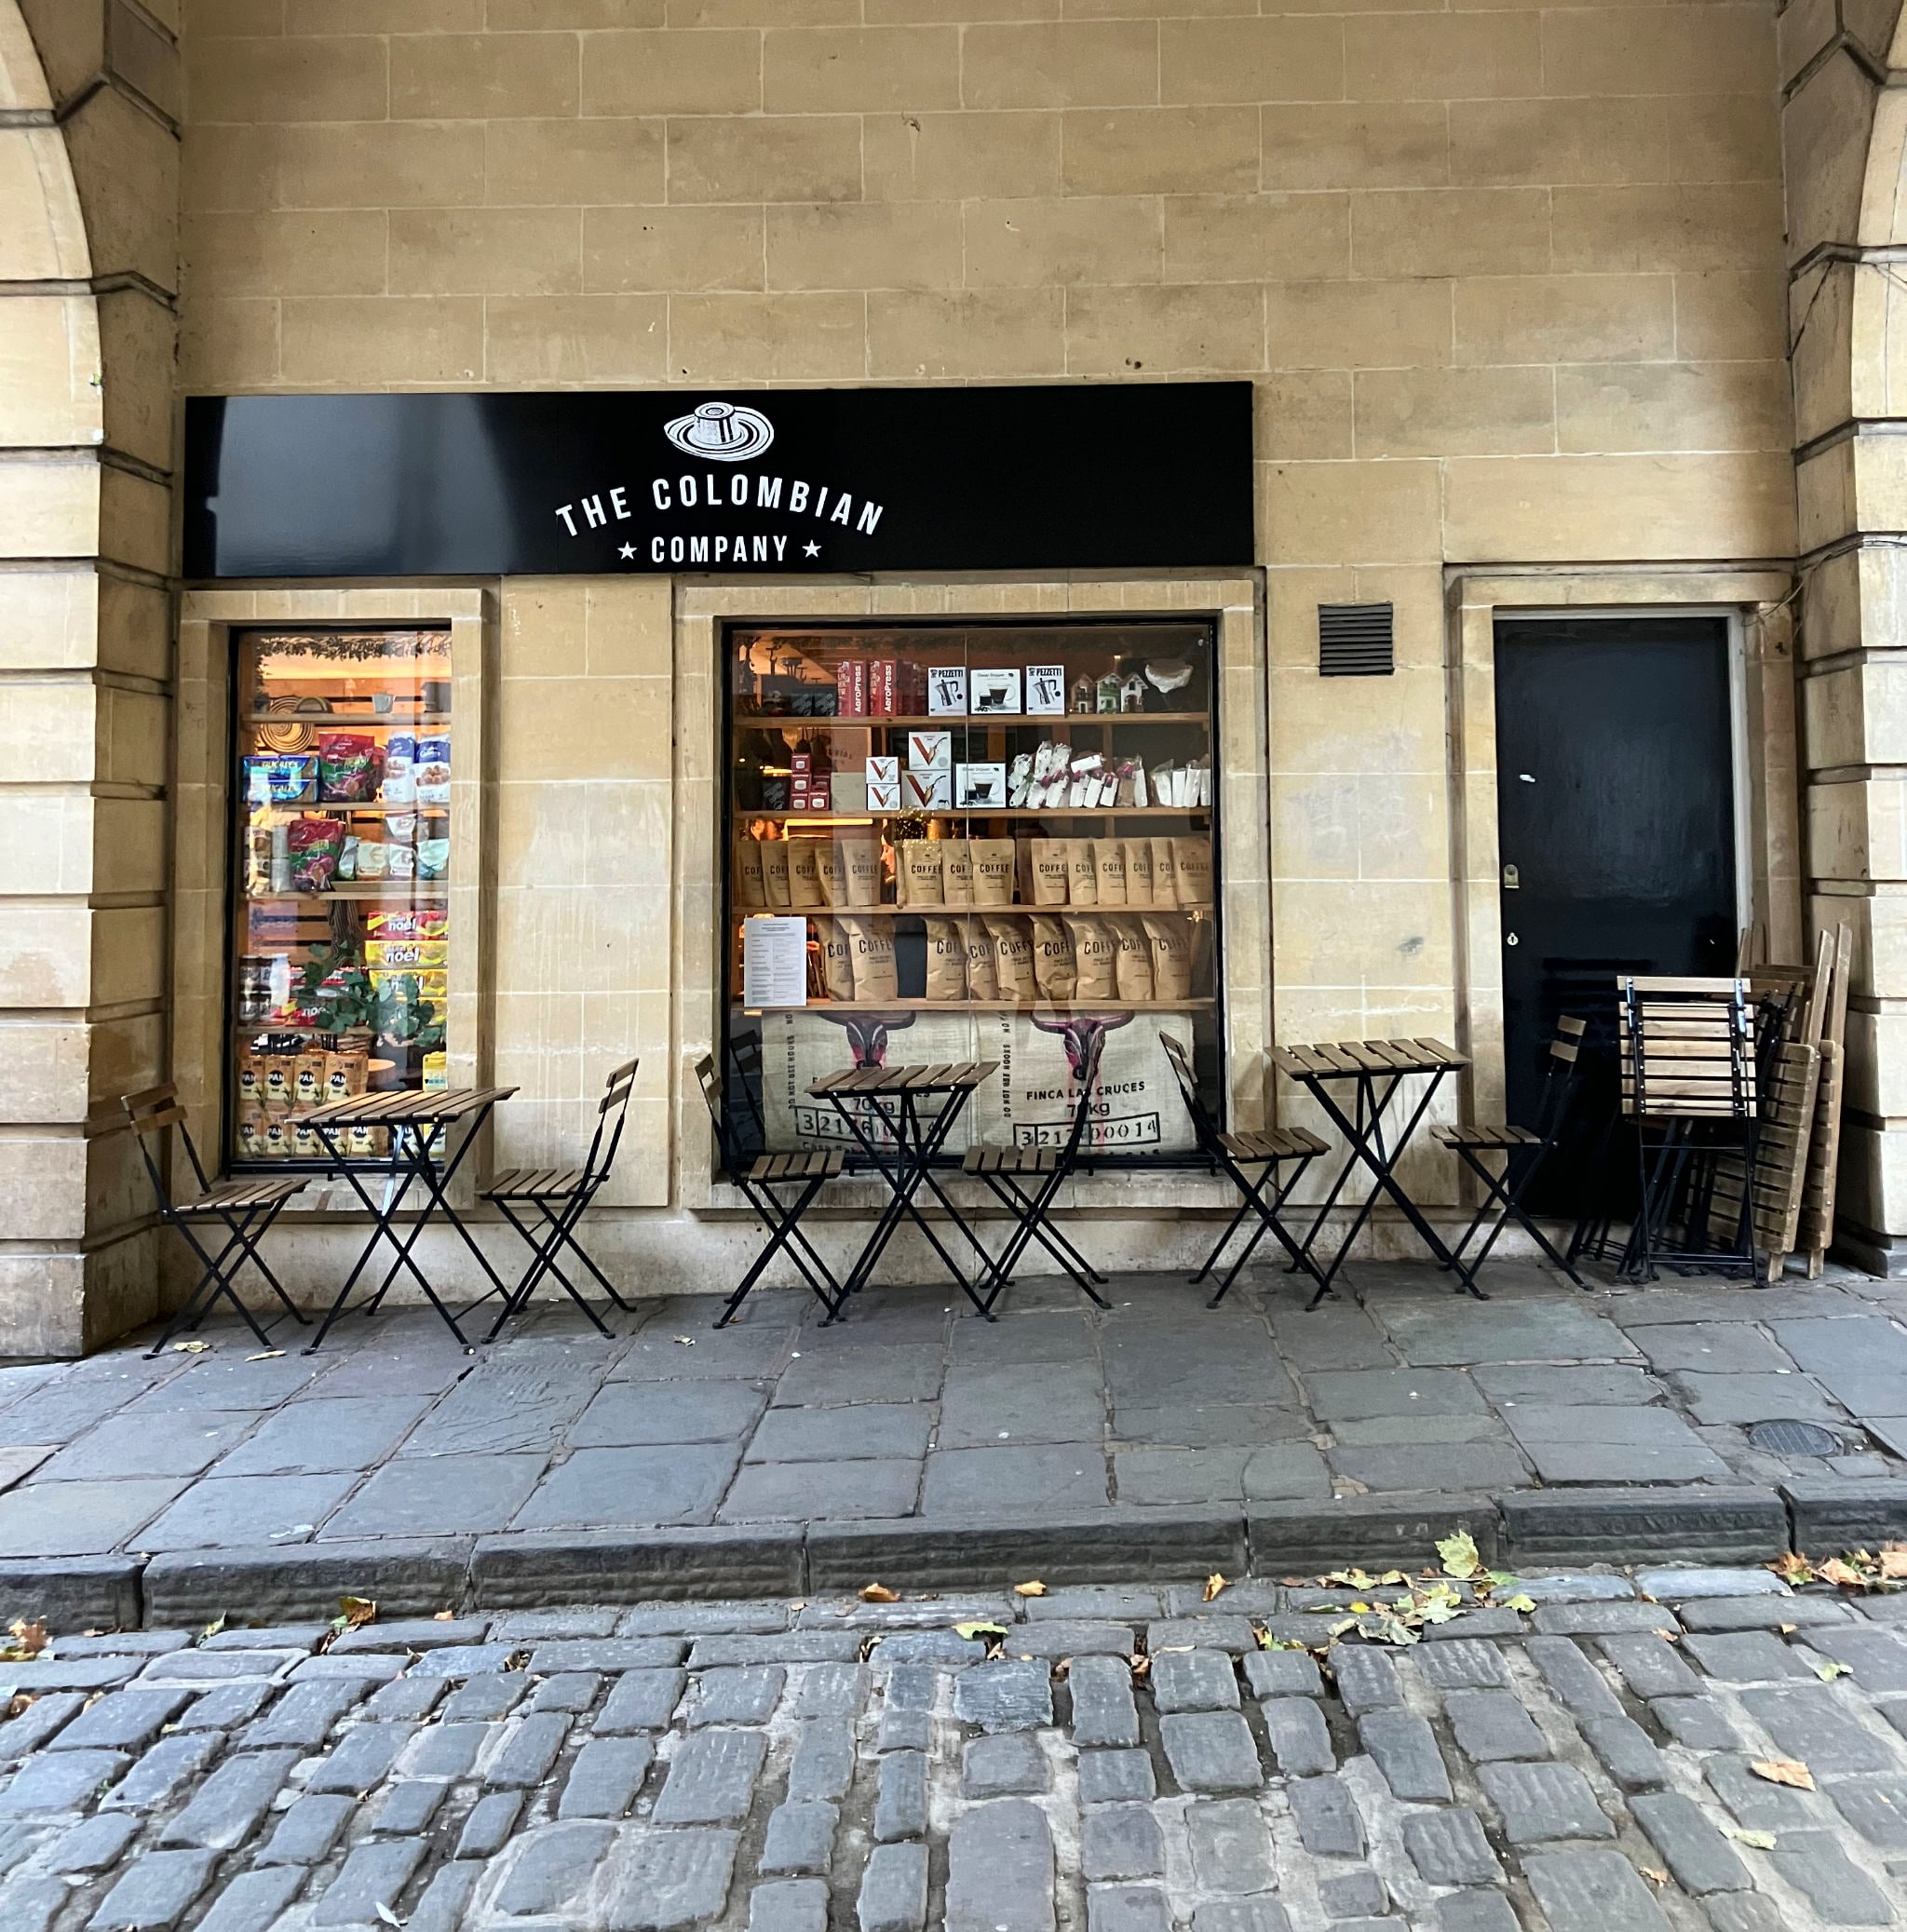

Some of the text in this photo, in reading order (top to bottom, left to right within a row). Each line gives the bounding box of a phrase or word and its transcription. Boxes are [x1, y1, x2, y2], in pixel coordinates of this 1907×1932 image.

[555, 473, 884, 537] THE COLOMBIAN
[651, 535, 788, 562] COMPANY
[938, 669, 964, 678] PEZZETTI
[1036, 668, 1062, 677] PEZZETTI
[884, 664, 892, 712] AeroPress
[852, 864, 878, 875] COFFEE
[980, 863, 1009, 873] COFFEE
[1039, 863, 1066, 873] COFFE
[388, 917, 416, 931] noel
[385, 947, 420, 963] noel
[1003, 1044, 1011, 1070] HOOKS
[268, 1073, 284, 1081] PAN
[299, 1074, 315, 1082] PAN
[330, 1074, 346, 1083] PAN
[1026, 1081, 1145, 1101] FINCA LA CRUCES
[267, 1127, 284, 1135] PAN
[352, 1126, 369, 1134] PAN
